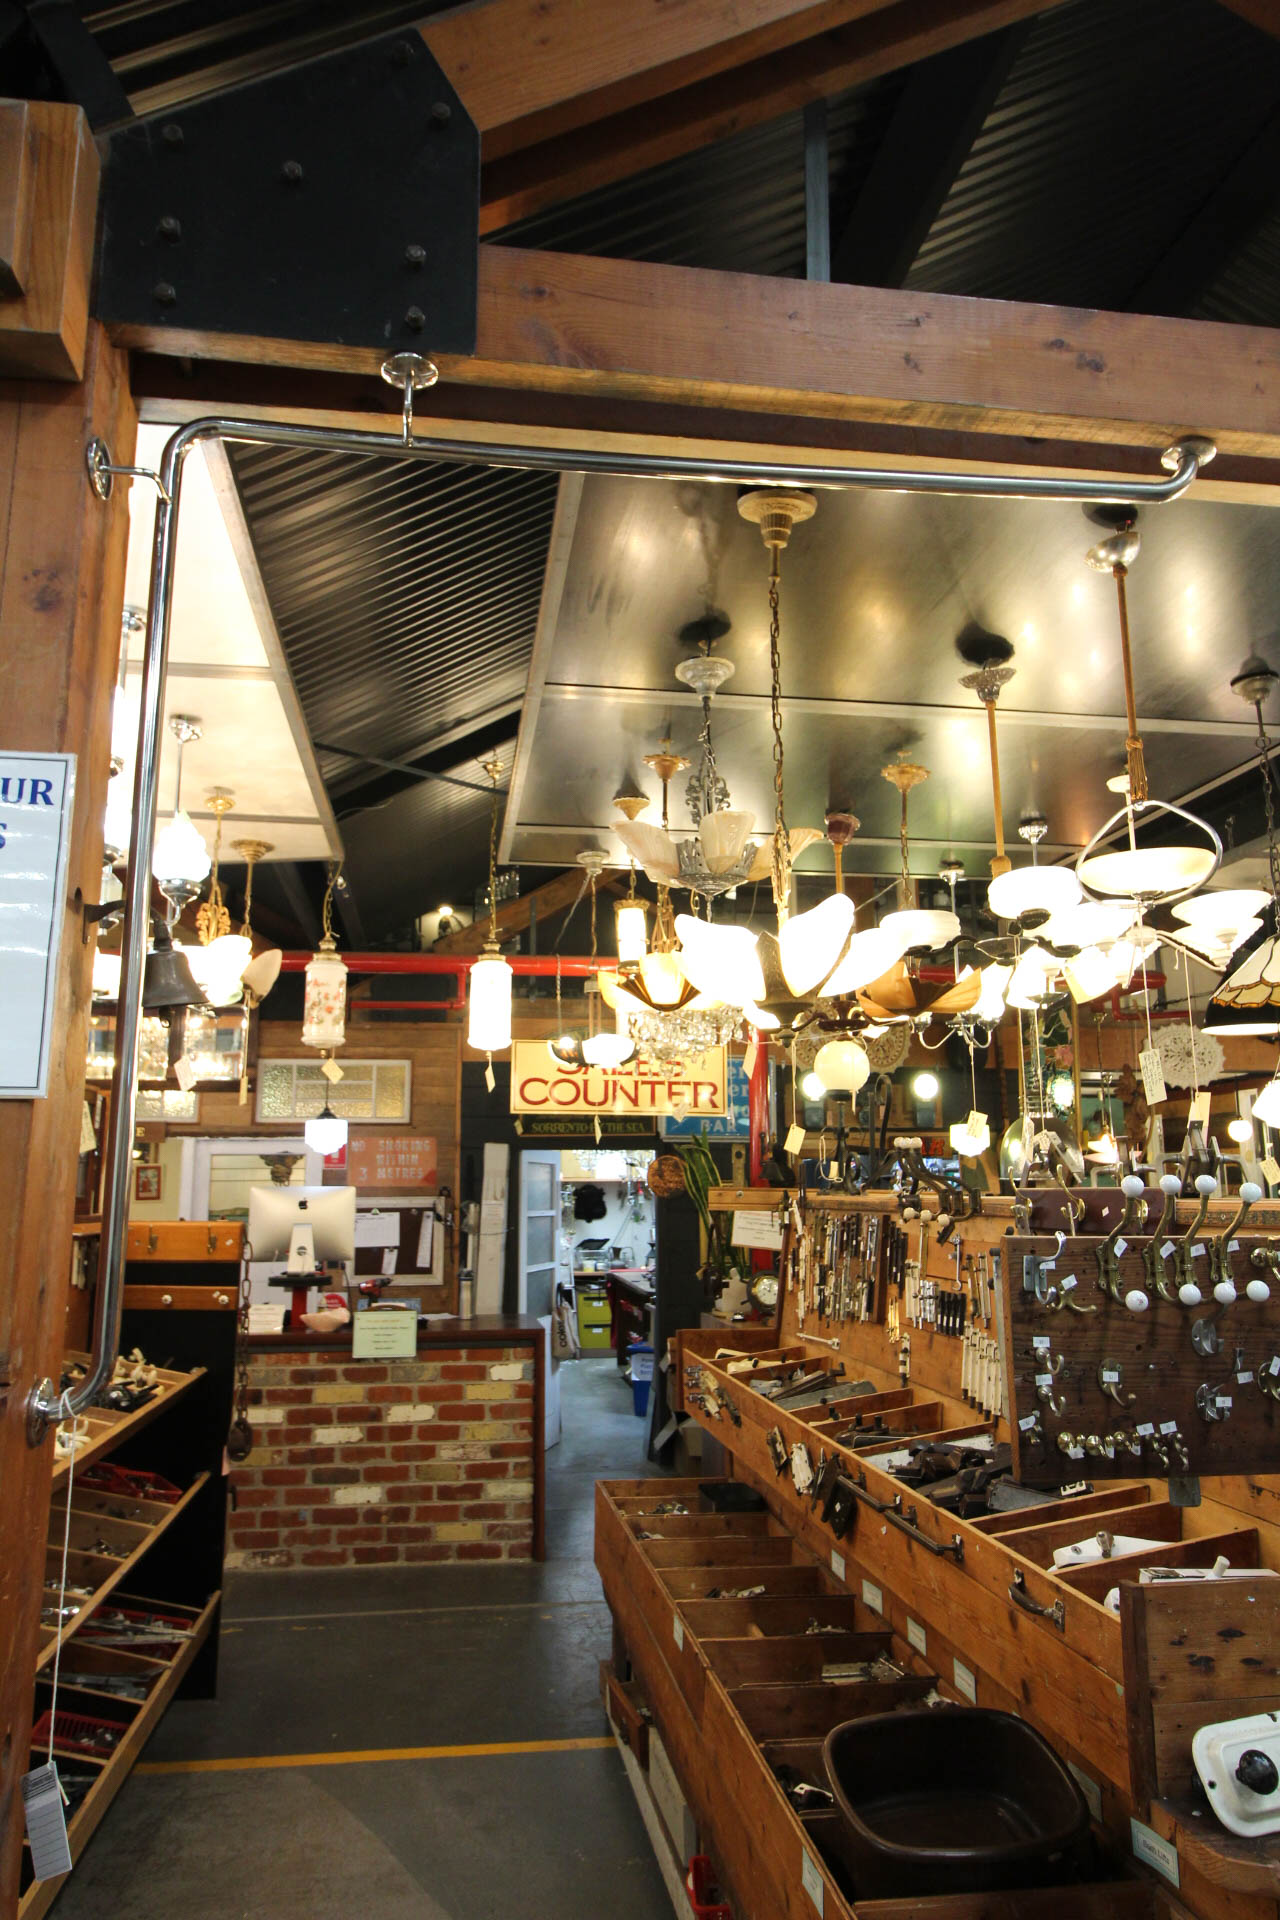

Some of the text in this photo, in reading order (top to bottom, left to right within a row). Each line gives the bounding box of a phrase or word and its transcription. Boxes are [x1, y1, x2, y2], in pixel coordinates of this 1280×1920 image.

[519, 1077, 720, 1109] COUNTER
[532, 1121, 588, 1133] SORRENTO
[700, 1118, 737, 1132] BAR
[351, 1139, 431, 1152] NO SMOKING
[376, 1153, 419, 1166] WITHIN
[377, 1167, 424, 1179] METRES
